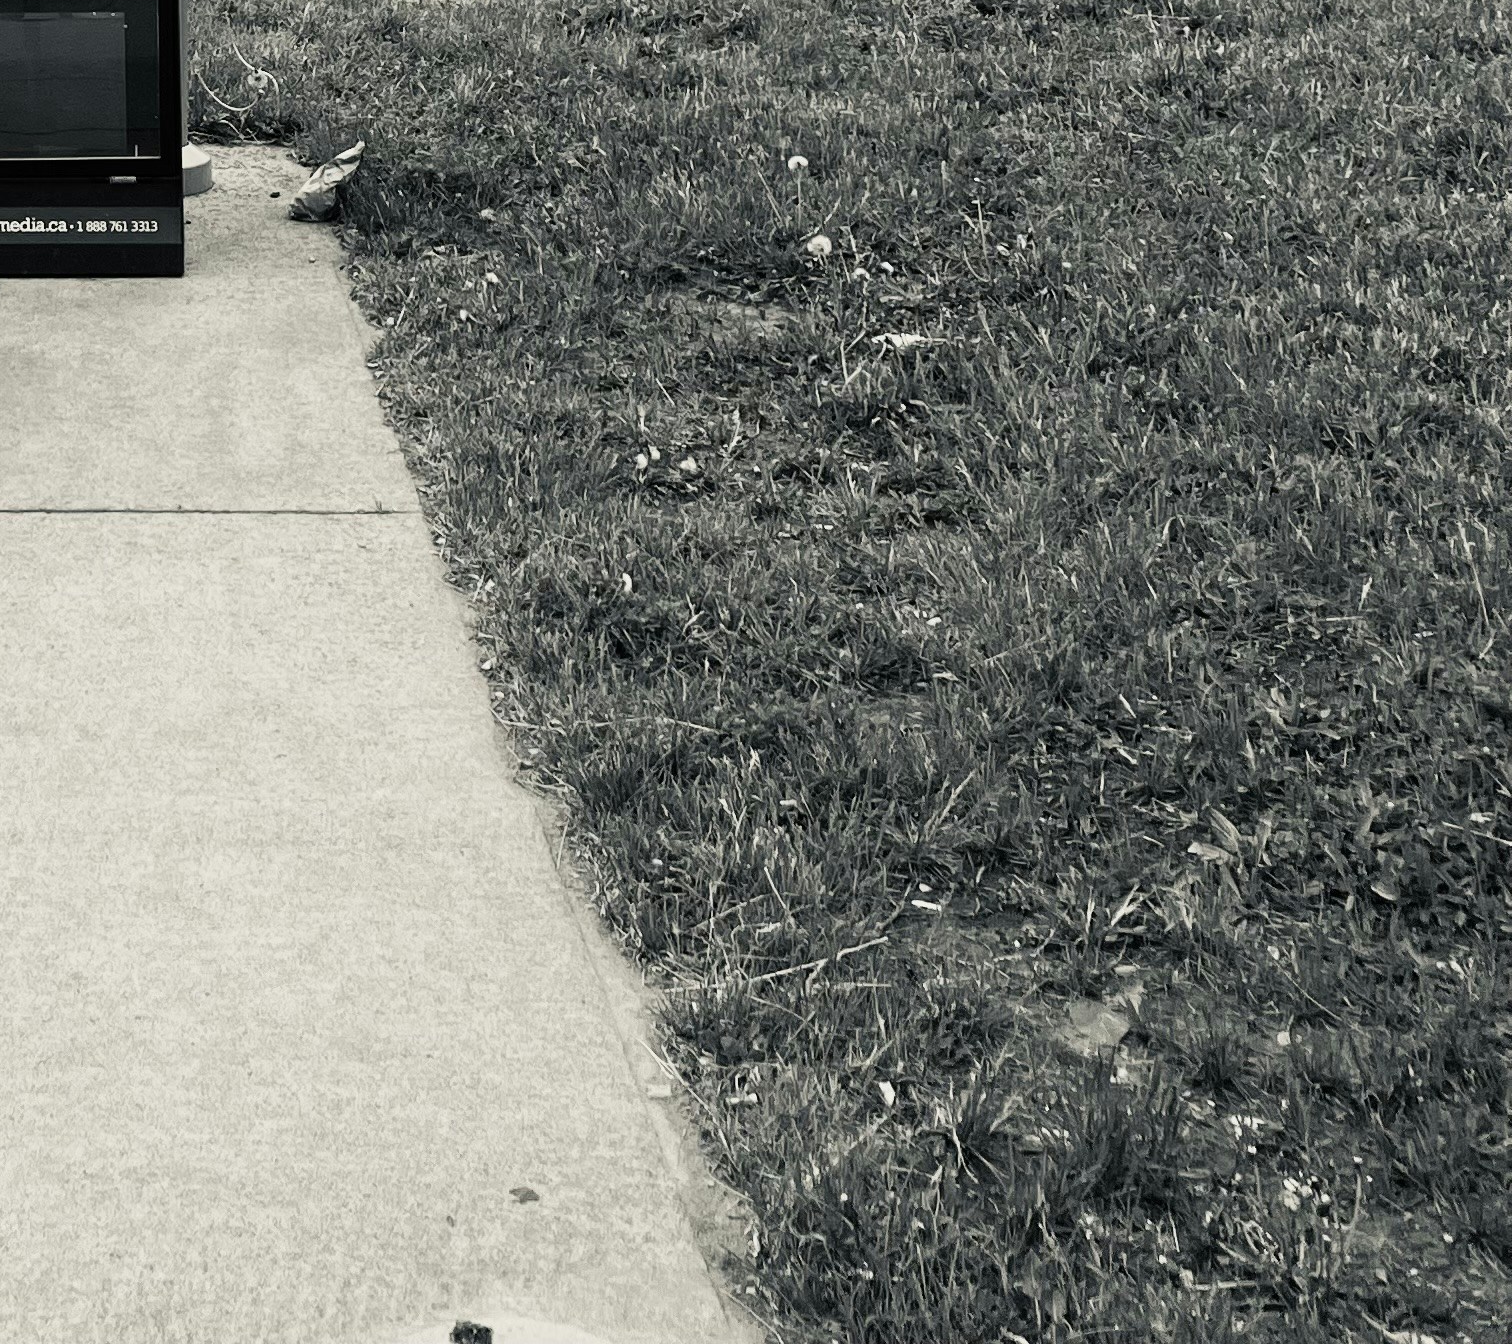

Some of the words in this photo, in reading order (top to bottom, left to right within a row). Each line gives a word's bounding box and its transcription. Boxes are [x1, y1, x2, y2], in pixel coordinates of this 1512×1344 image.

[77, 221, 84, 232] 1
[86, 221, 108, 233] 888
[110, 221, 128, 233] 761
[131, 221, 159, 232] 3313
